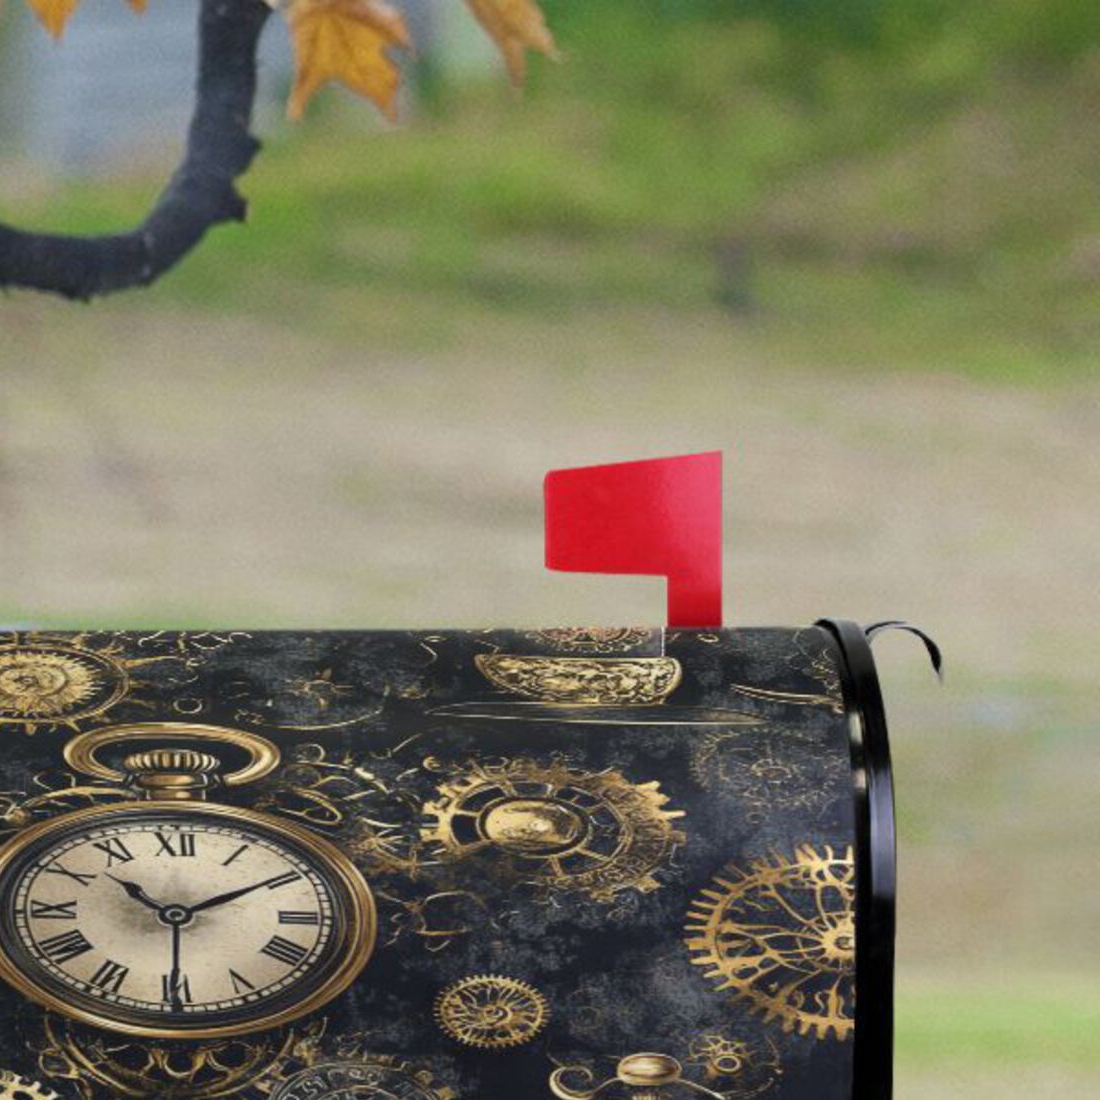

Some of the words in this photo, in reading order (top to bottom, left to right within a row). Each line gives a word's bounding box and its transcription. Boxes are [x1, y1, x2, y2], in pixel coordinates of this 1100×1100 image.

[92, 837, 135, 868] XI
[153, 831, 197, 857] XII
[46, 861, 98, 887] X
[31, 899, 78, 920] IX
